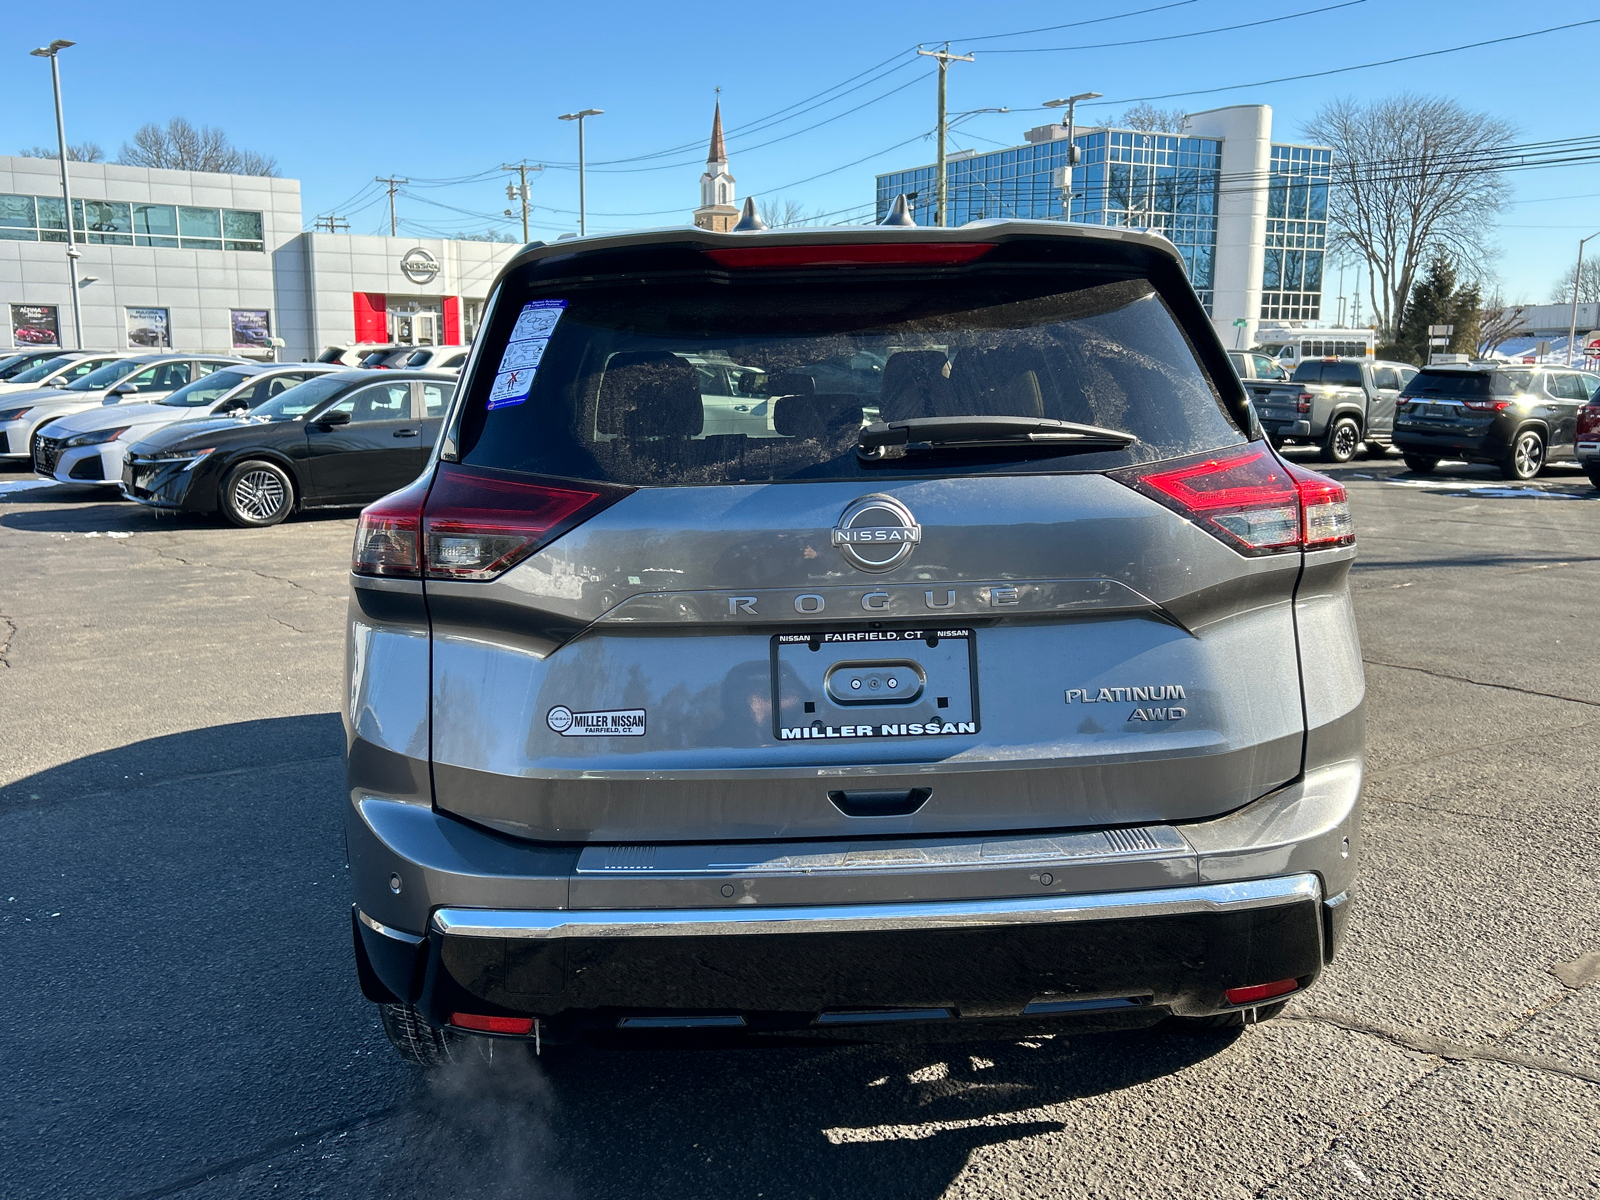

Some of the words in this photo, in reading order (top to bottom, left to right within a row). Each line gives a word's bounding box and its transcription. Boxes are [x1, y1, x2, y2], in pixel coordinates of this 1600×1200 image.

[837, 529, 916, 541] NISSAN
[728, 587, 1020, 615] ROGUE
[825, 632, 900, 642] FAIRFIELD,
[904, 631, 924, 639] CT
[1064, 685, 1186, 704] PLATINUM
[574, 715, 608, 727] MILLER
[611, 715, 644, 727] NISSAN
[1126, 707, 1186, 722] AWD
[781, 725, 873, 739] MILLER
[881, 722, 976, 736] NISSAN
